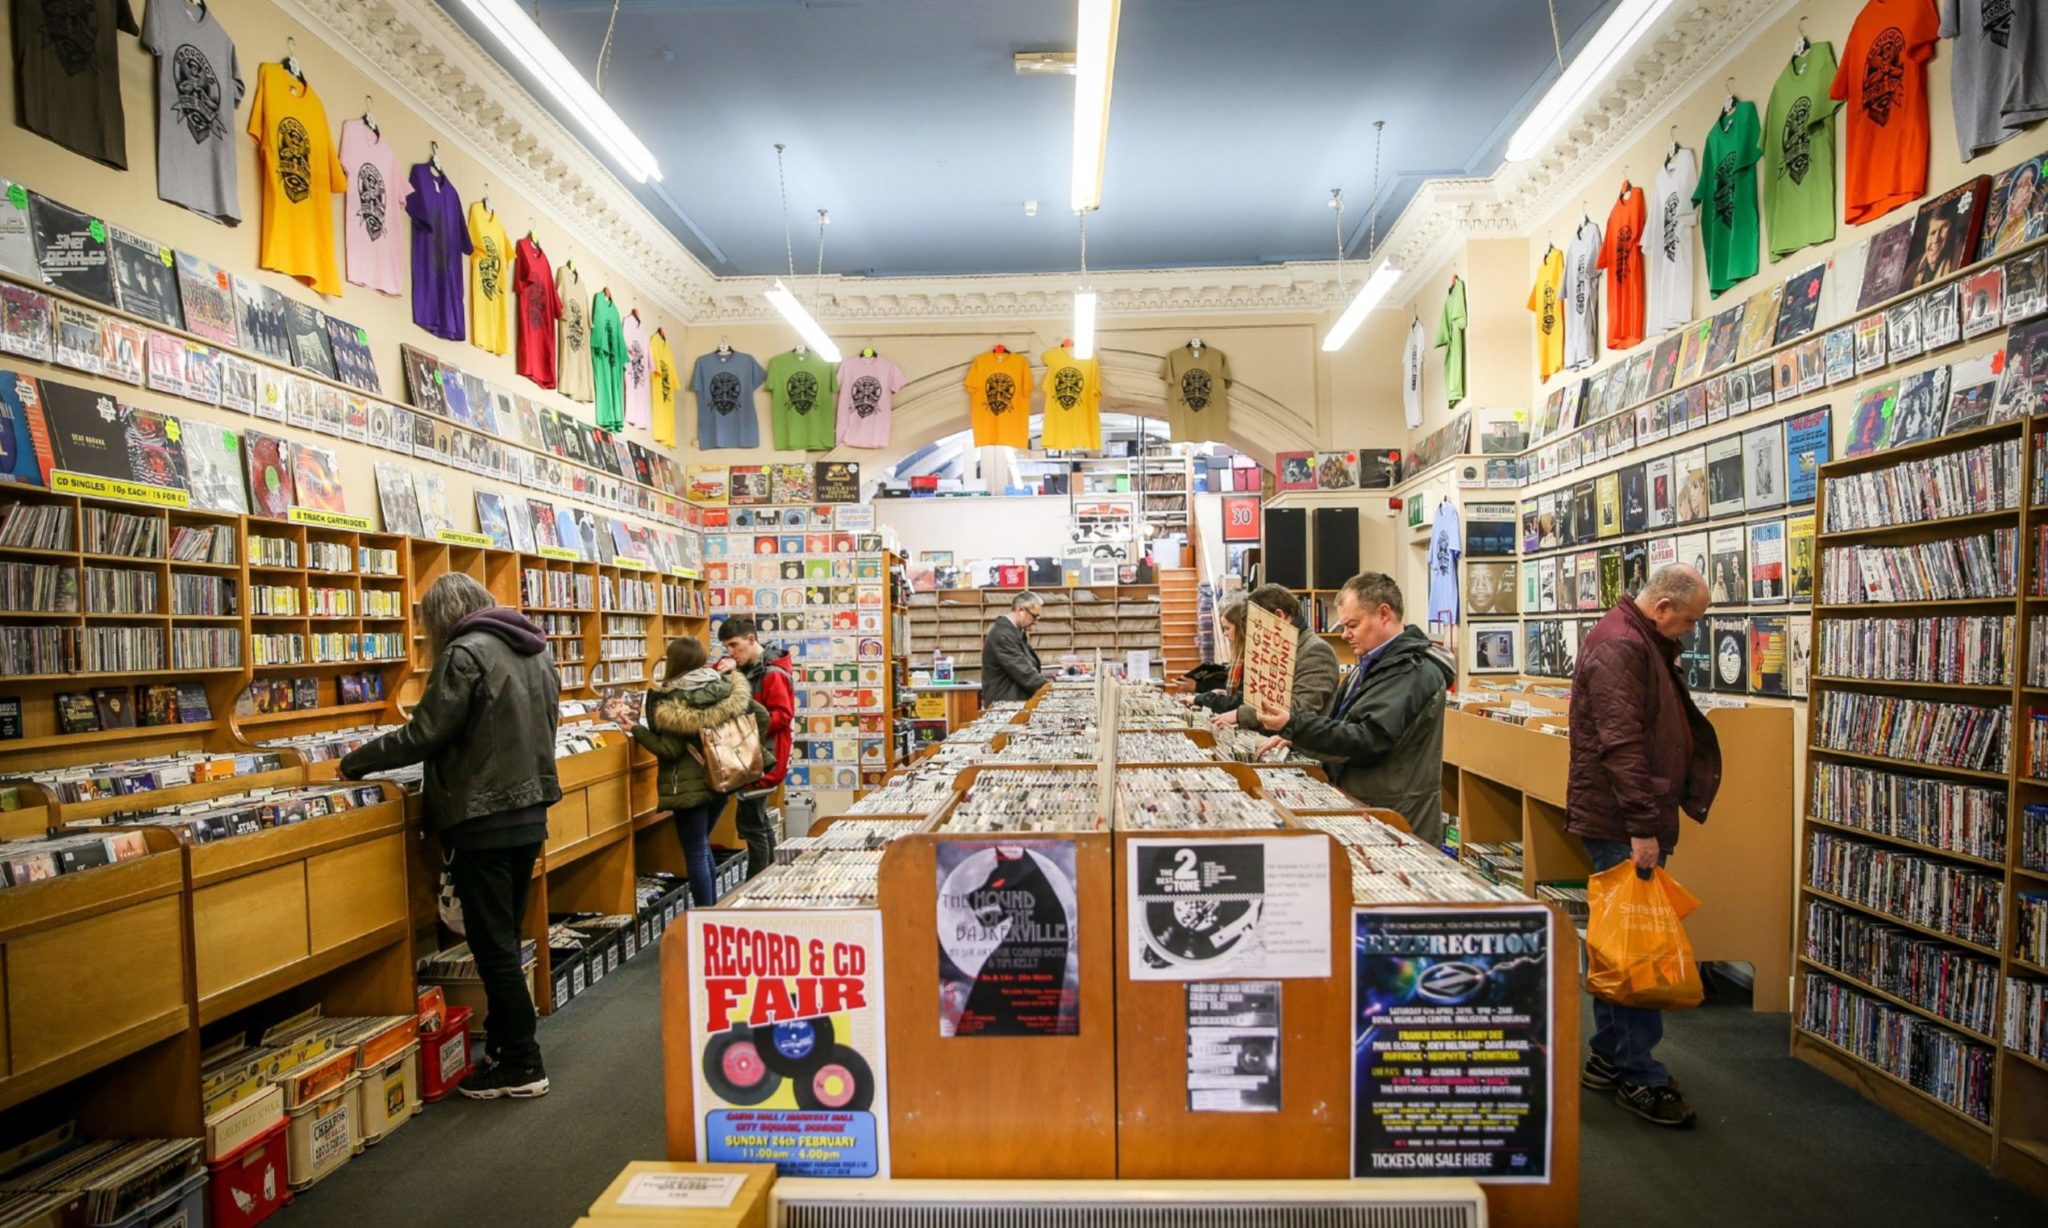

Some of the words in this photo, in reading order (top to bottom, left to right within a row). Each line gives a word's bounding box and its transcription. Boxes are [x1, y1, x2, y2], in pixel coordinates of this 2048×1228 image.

[56, 477, 68, 486] CD
[71, 479, 106, 492] SINGLES
[112, 485, 126, 496] 10p
[128, 487, 147, 497] EACH
[162, 491, 176, 501] FOR
[296, 511, 302, 520] 8
[303, 513, 326, 523] TRACK
[327, 516, 367, 529] CARTRIDGES
[1232, 507, 1252, 526] 30
[1067, 545, 1093, 556] SPECIALS
[1249, 618, 1263, 695] WINGS
[1261, 629, 1272, 666] THE
[1276, 639, 1291, 706] SOUND
[1258, 670, 1268, 697] AT
[1160, 869, 1173, 877] THE
[1174, 848, 1199, 880] 2
[1156, 877, 1174, 886] BEST
[1163, 884, 1174, 893] OF
[1173, 879, 1201, 893] TONE
[942, 893, 970, 909] THE
[975, 891, 1036, 909] HOUND
[1004, 909, 1034, 926] THE
[956, 923, 1076, 943] BASKERVILLES
[702, 922, 801, 978] RECORD
[809, 938, 825, 976] &
[833, 942, 867, 977] CD
[1365, 933, 1540, 956] REZERECTION
[705, 977, 867, 1033] FAIR
[1389, 1007, 1422, 1015] SATURDAY
[1372, 1015, 1393, 1024] ROYAL
[725, 1135, 770, 1147] SUNDAY
[772, 1136, 796, 1147] 24th
[798, 1136, 857, 1148] FEBRUARY
[742, 1149, 789, 1160] 11.00am
[1371, 1153, 1416, 1168] TICKETS
[1417, 1153, 1435, 1168] ON
[1435, 1153, 1462, 1168] SALE
[1463, 1153, 1493, 1167] HERE
